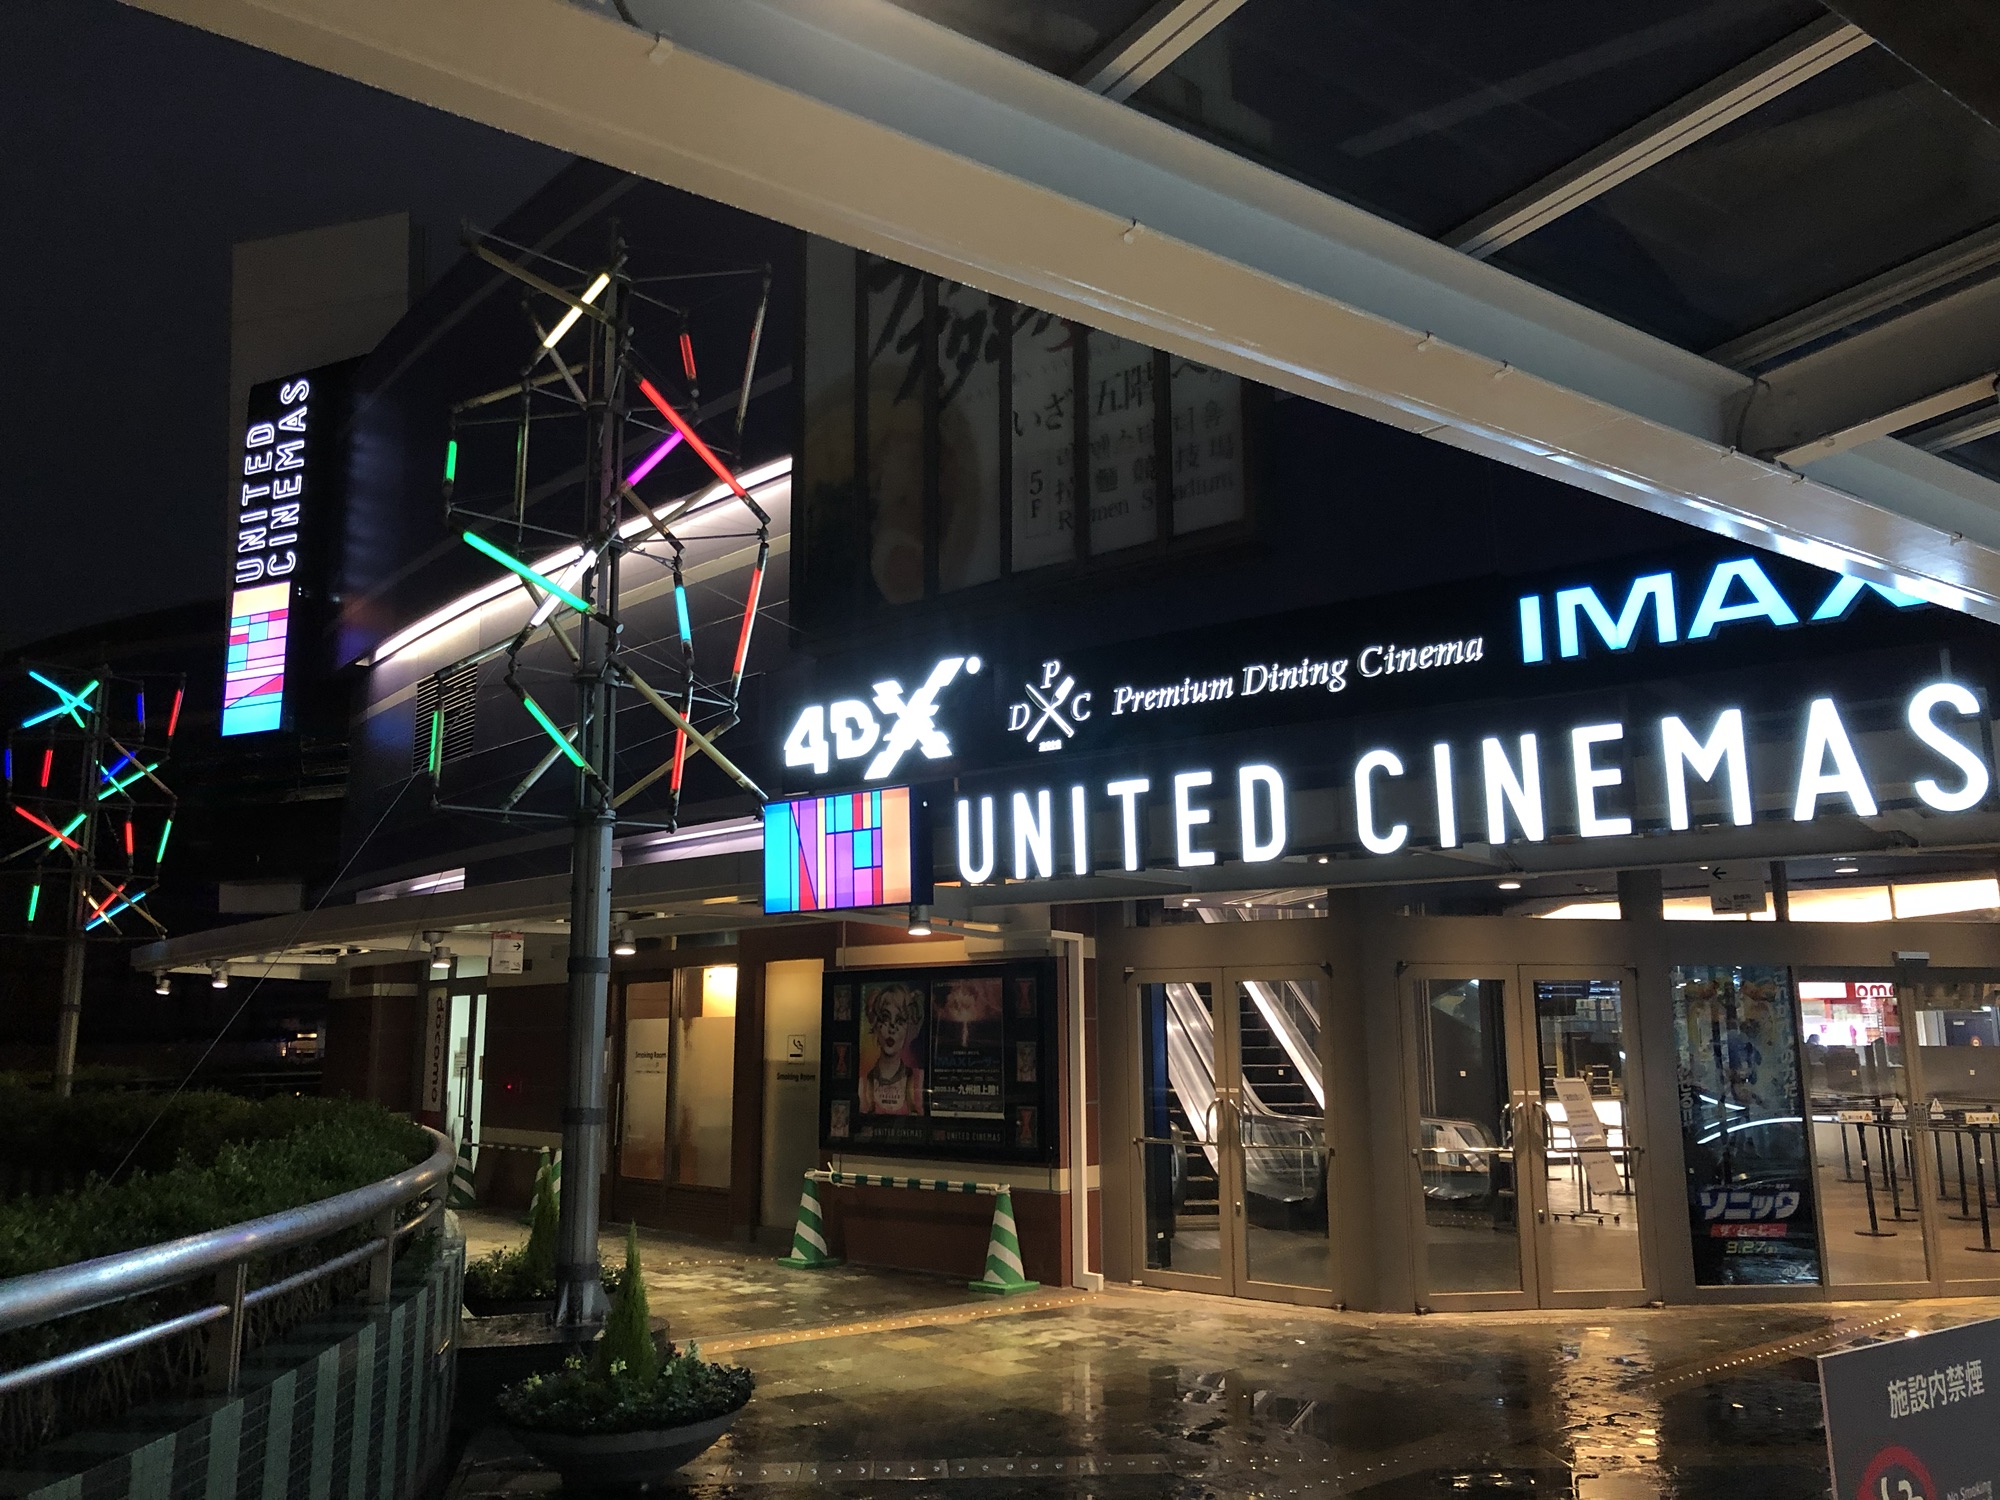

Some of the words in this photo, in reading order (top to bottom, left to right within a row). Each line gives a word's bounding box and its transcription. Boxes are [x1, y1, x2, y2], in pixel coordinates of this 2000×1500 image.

[236, 423, 275, 583] UNITED
[267, 379, 310, 576] CINEMAS
[1058, 500, 1129, 531] Rmen
[1142, 475, 1234, 512] Sadium
[1111, 676, 1234, 716] Premium
[1241, 658, 1349, 696] Dining
[1358, 636, 1484, 678] Cinema
[784, 656, 966, 780] 4DX
[956, 763, 1288, 885] UNITED
[1353, 682, 1990, 856] CINEMAS
[431, 996, 445, 1103] docomo
[635, 1051, 653, 1060] Smoking
[654, 1050, 667, 1058] Room
[776, 1071, 799, 1082] Smoking
[800, 1072, 816, 1081] Room
[1700, 1191, 1800, 1220] ソニック
[1887, 1359, 1985, 1419] 施設内禁煙
